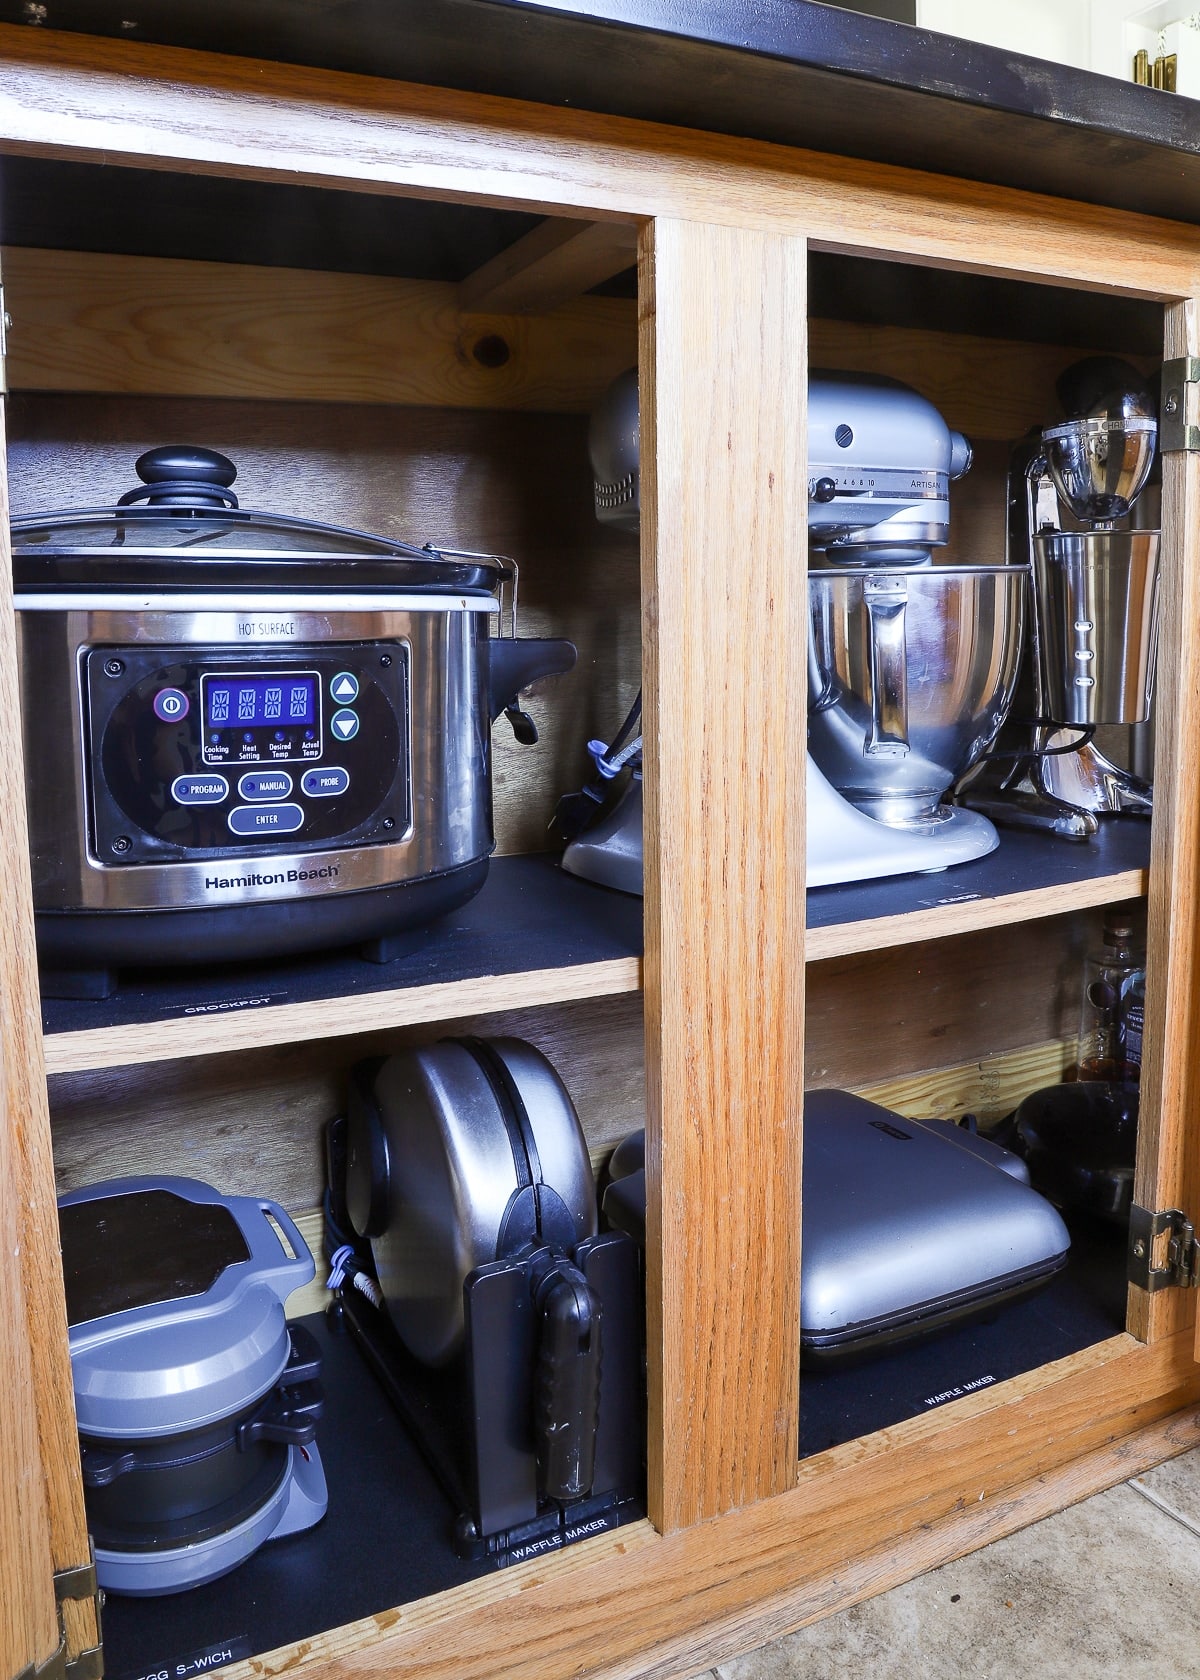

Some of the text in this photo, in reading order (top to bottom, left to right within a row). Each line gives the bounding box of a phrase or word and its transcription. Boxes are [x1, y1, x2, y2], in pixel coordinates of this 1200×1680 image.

[910, 479, 941, 489] ARTISAN
[238, 622, 295, 636] HOT SURFACE
[242, 744, 257, 752] Heat
[269, 742, 291, 751] Desired
[302, 740, 320, 749] Actual
[204, 745, 229, 754] Cooking
[303, 749, 319, 757] Temp
[207, 753, 223, 761] Time
[239, 752, 260, 761] Setting
[272, 750, 289, 759] Temp
[259, 782, 287, 791] MANUAL
[320, 777, 339, 787] PROBE
[190, 785, 224, 794] PROGRAM
[256, 815, 278, 825] ENTER
[205, 865, 339, 889] Hamilton Beach
[184, 998, 271, 1013] CROCKPOT
[924, 1375, 997, 1405] WAFFLE MAKER
[512, 1519, 608, 1559] WAFFLE MAKER
[176, 1649, 232, 1675] S-WICH
